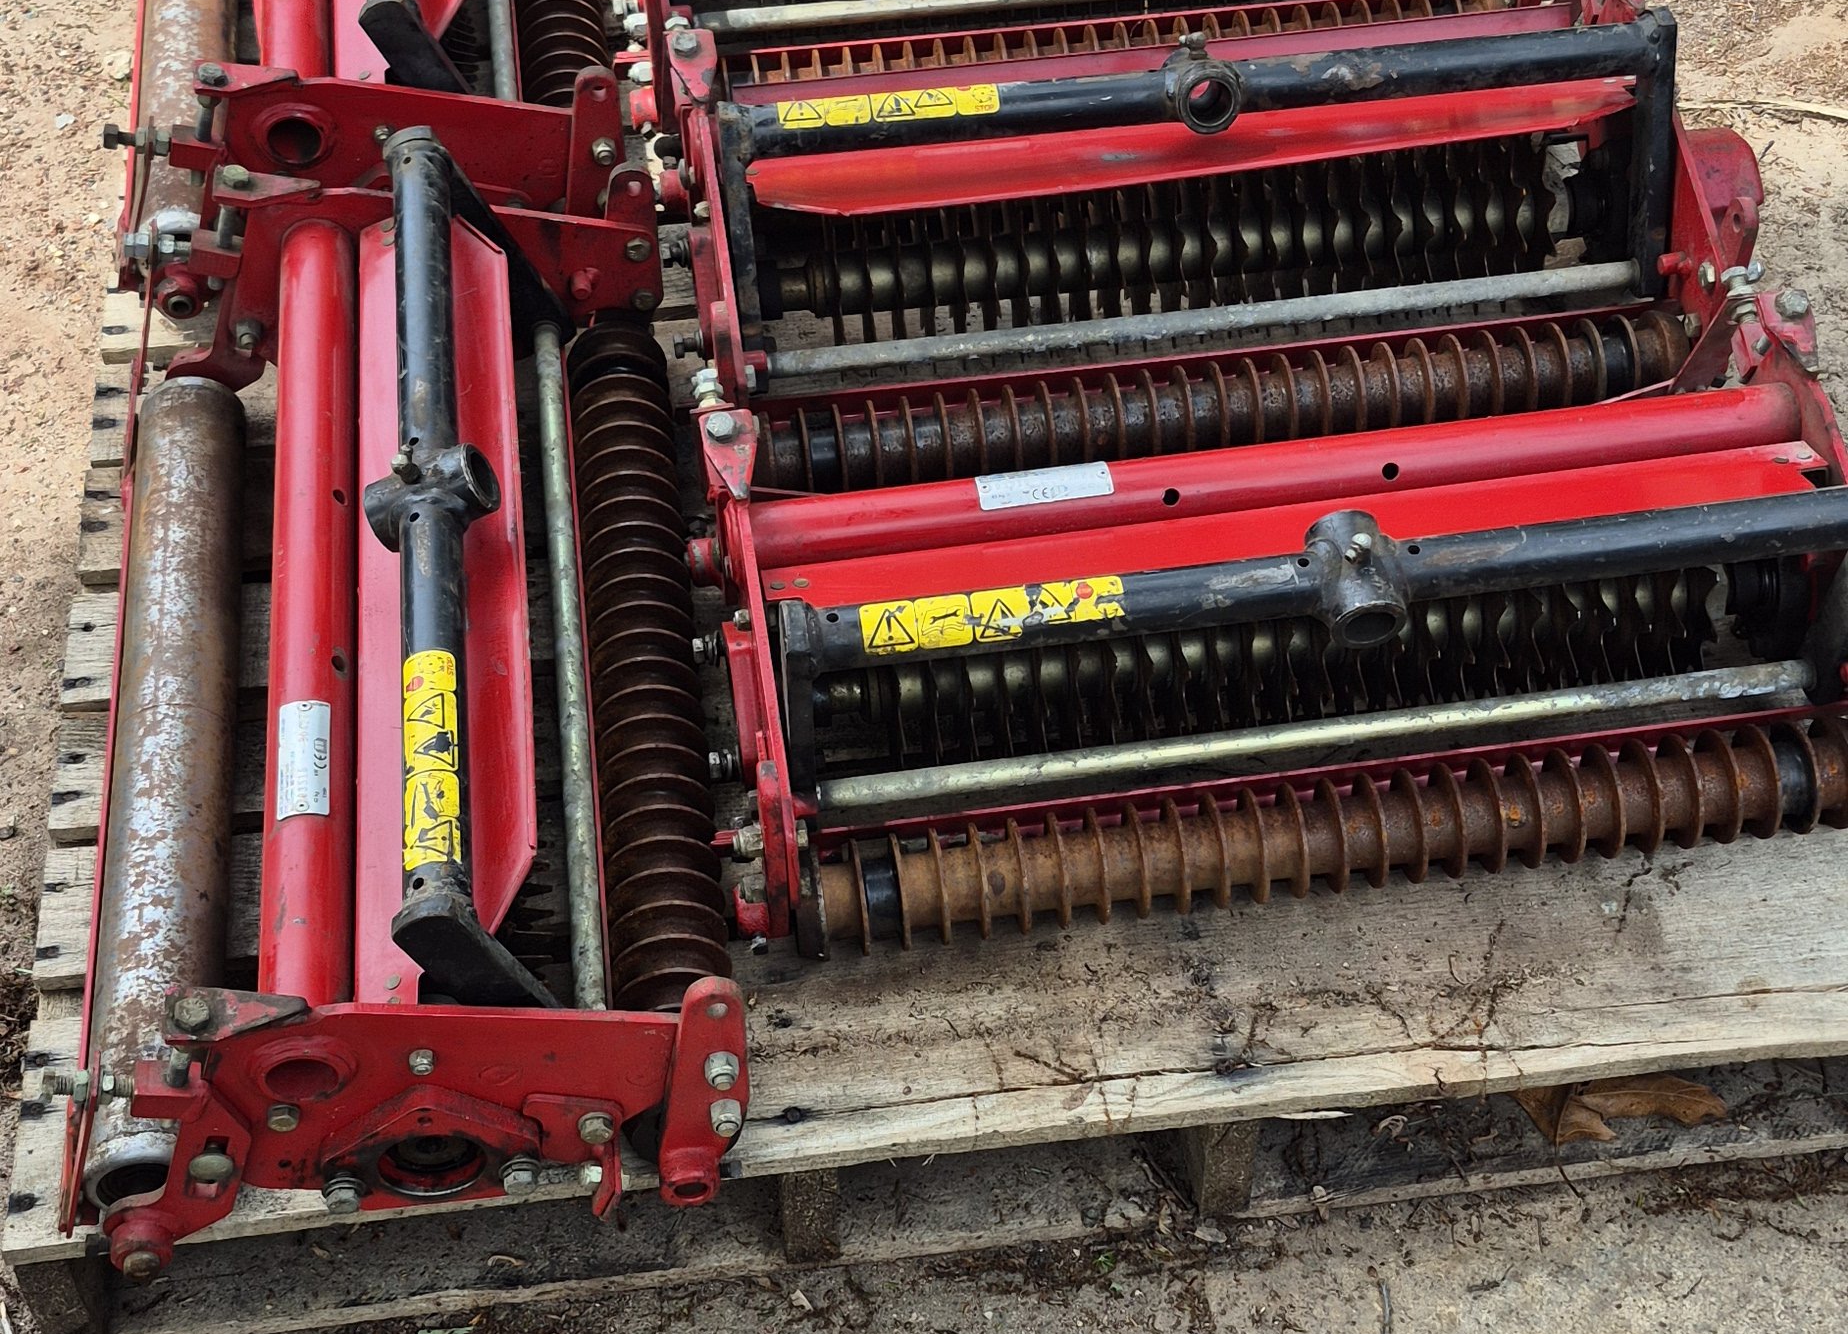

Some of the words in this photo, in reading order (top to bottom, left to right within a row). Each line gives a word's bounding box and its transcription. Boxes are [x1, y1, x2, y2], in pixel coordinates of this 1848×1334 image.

[975, 104, 994, 112] STOP
[446, 656, 454, 676] STOP
[313, 754, 327, 769] CE
